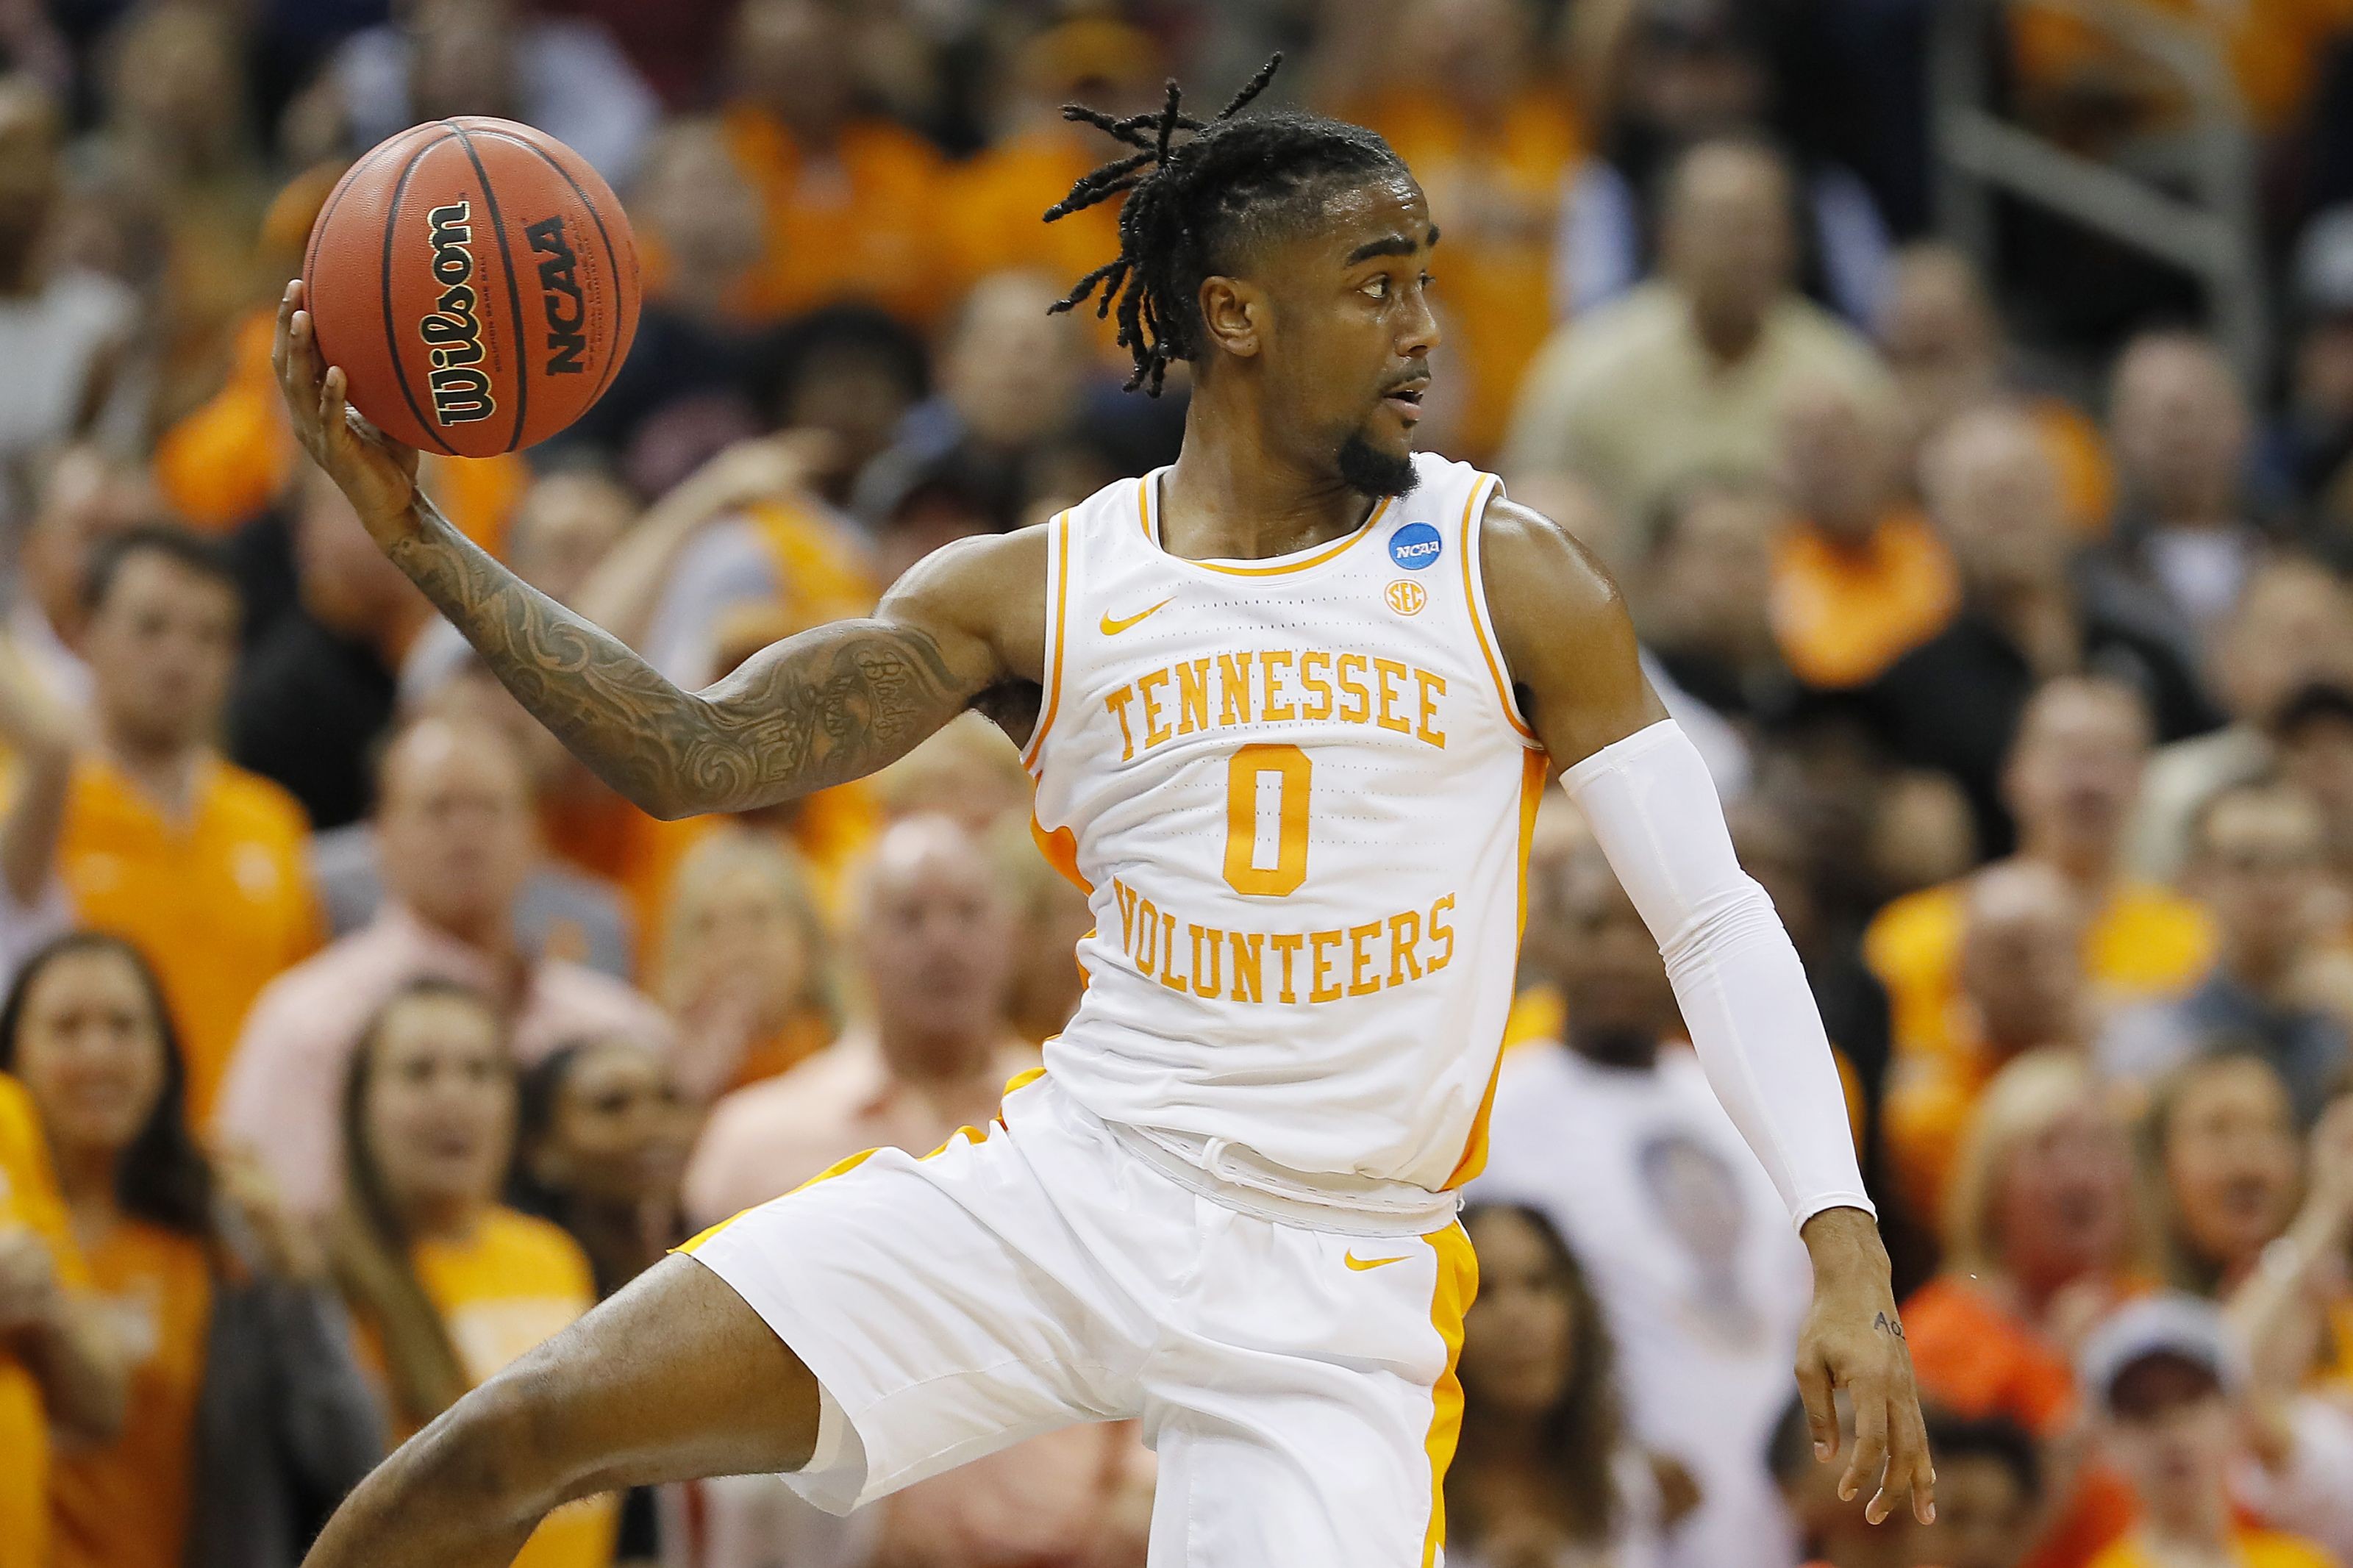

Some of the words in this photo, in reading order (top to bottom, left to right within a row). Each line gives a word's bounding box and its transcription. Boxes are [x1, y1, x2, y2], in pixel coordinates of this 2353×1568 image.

[418, 201, 496, 426] Wilson
[525, 215, 586, 376] NCAA
[1388, 581, 1423, 612] SEC
[1396, 540, 1440, 559] NCAA
[1105, 651, 1449, 762] TENNESSEE
[1222, 743, 1313, 898] 0
[1113, 876, 1456, 1003] VOLUNTEERS
